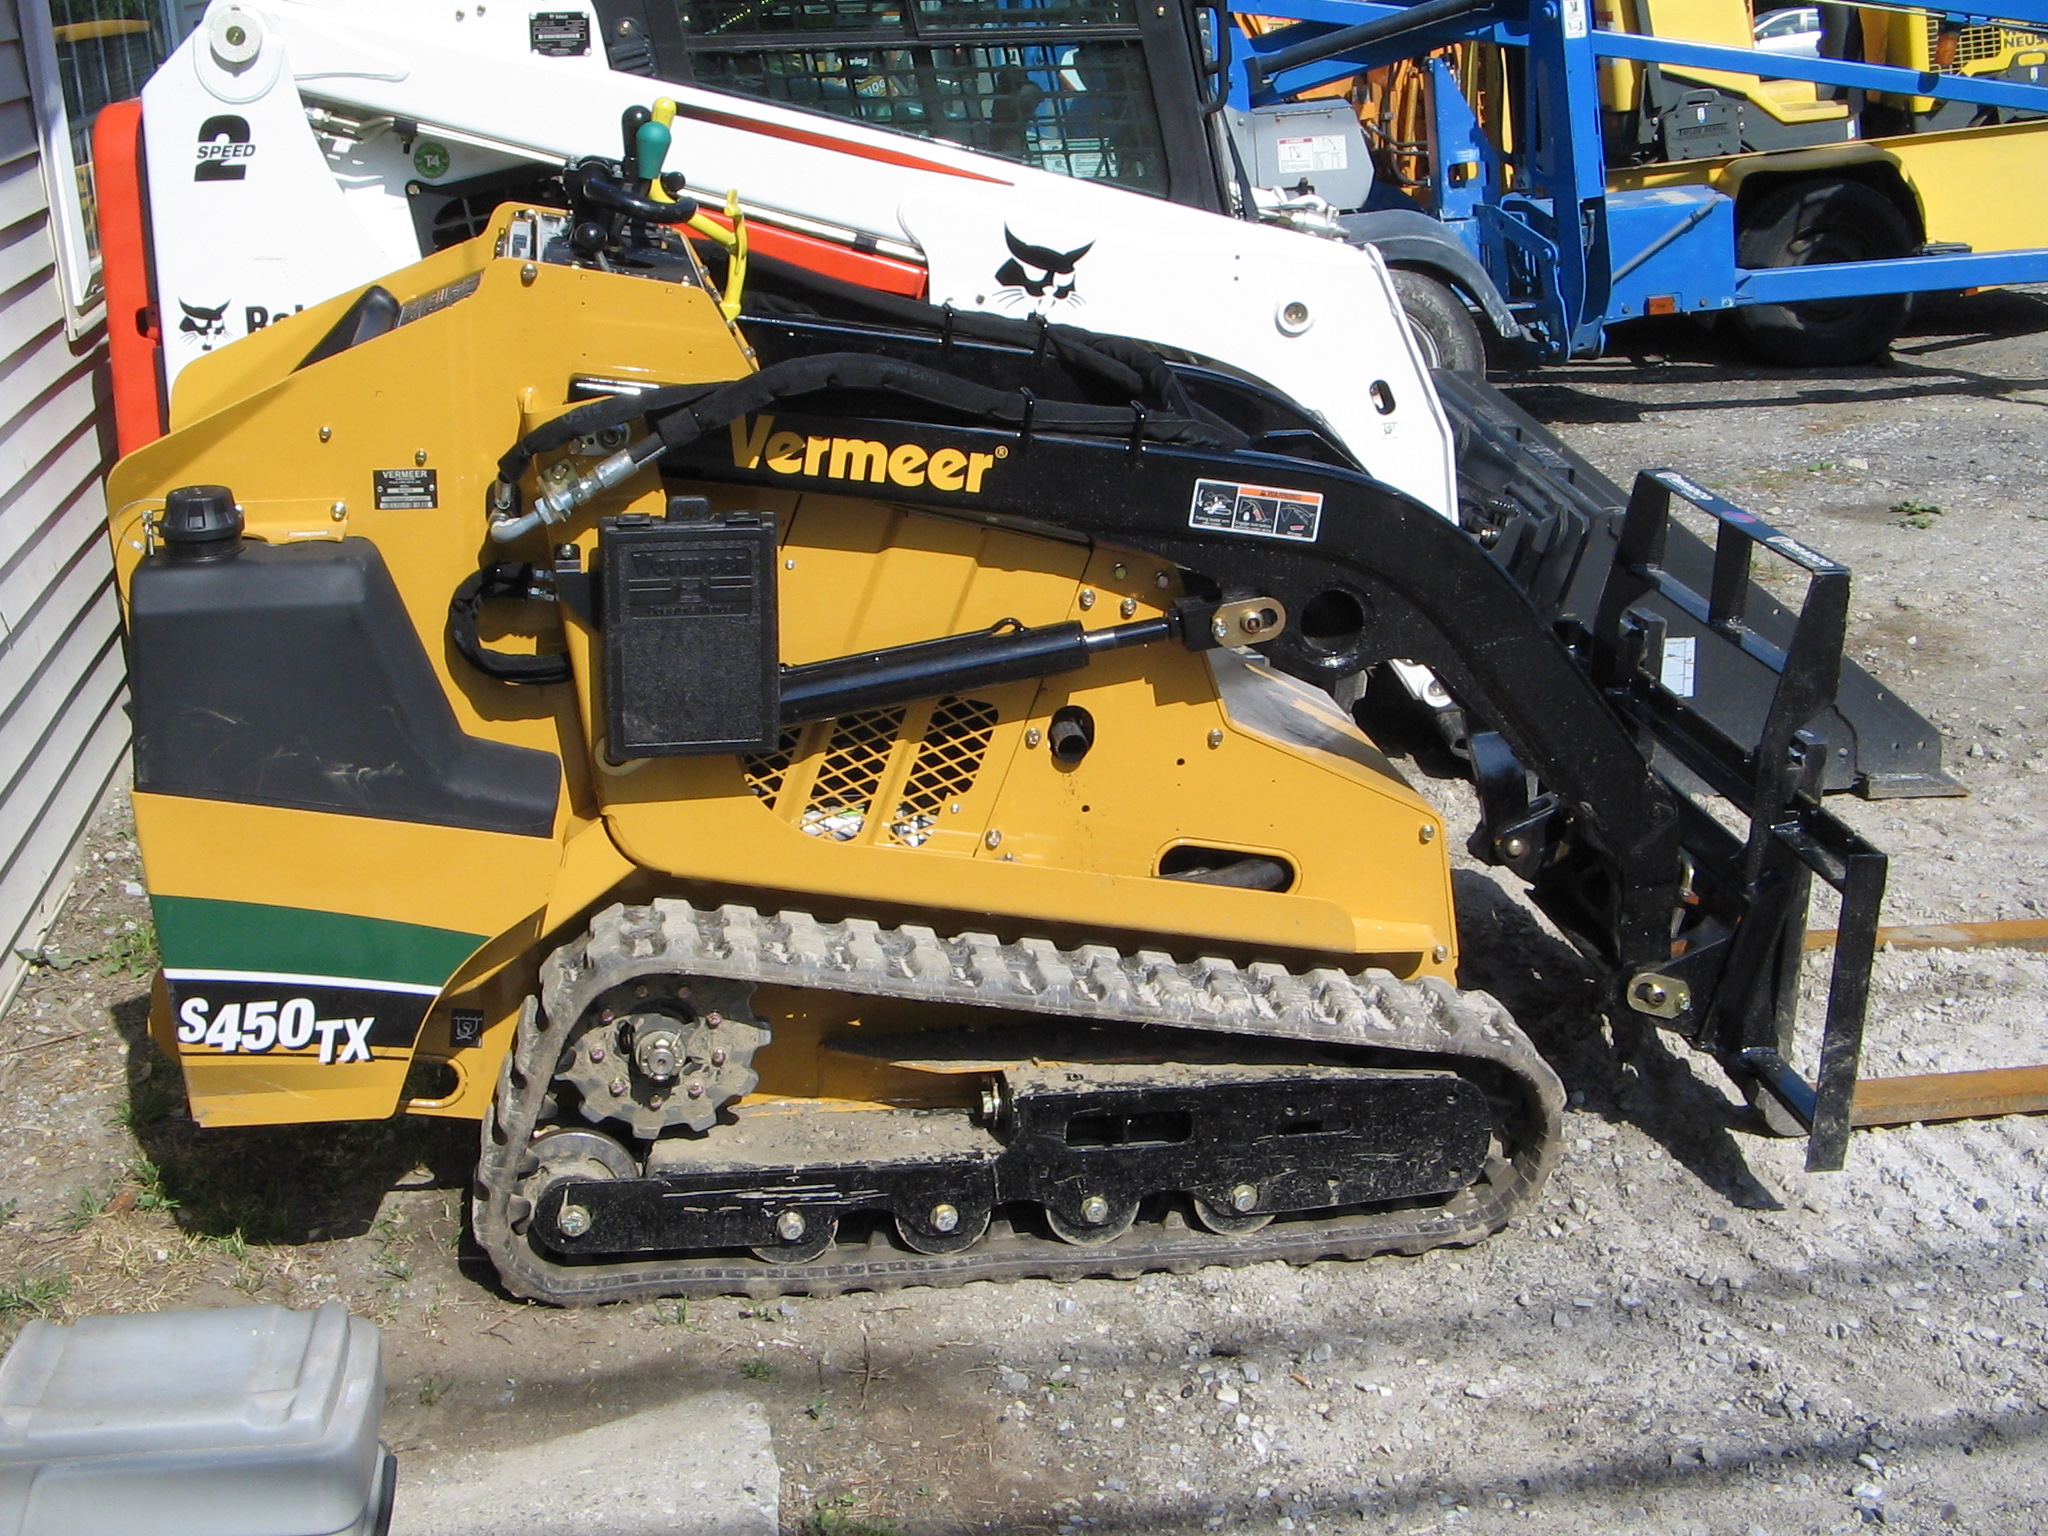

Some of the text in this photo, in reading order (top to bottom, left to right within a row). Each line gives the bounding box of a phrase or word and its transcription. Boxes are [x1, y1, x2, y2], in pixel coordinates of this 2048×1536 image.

[194, 114, 251, 182] 2
[196, 144, 257, 160] SPEED
[382, 470, 429, 479] VERMEER
[729, 413, 995, 494] Vermeer
[178, 997, 376, 1064] S450TX
